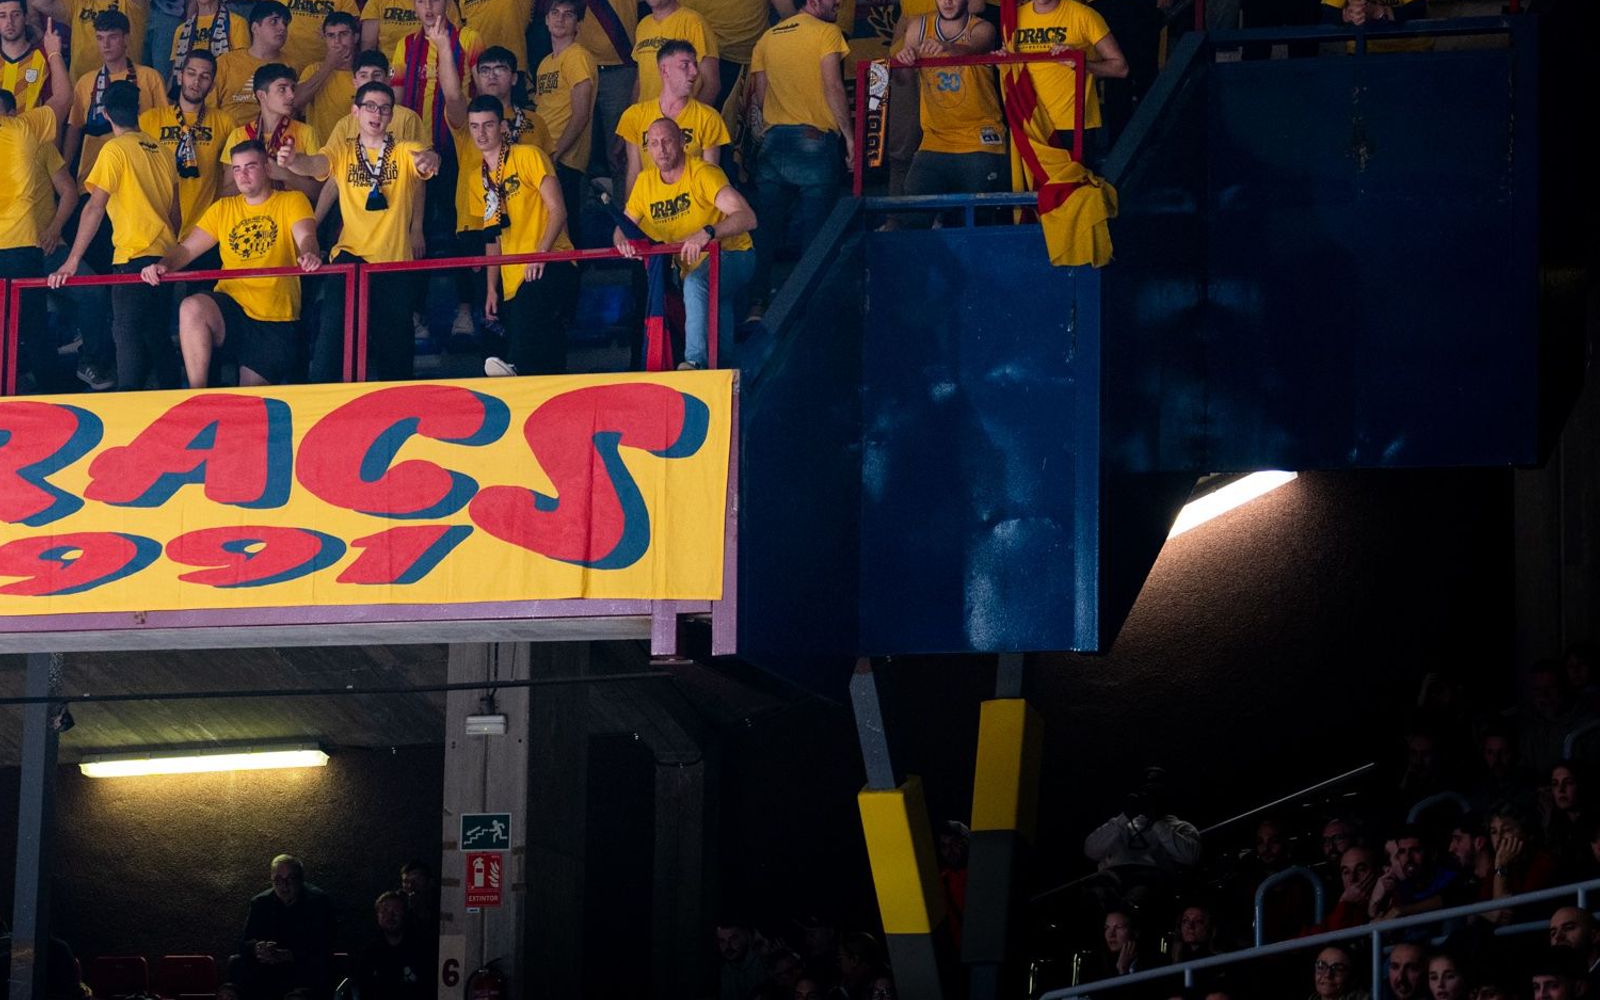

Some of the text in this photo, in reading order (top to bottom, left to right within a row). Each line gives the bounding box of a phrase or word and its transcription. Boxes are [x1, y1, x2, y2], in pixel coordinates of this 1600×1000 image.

[1015, 27, 1067, 44] DRACS
[936, 71, 961, 91] 30
[650, 192, 691, 219] DRACS
[442, 958, 460, 988] 6
